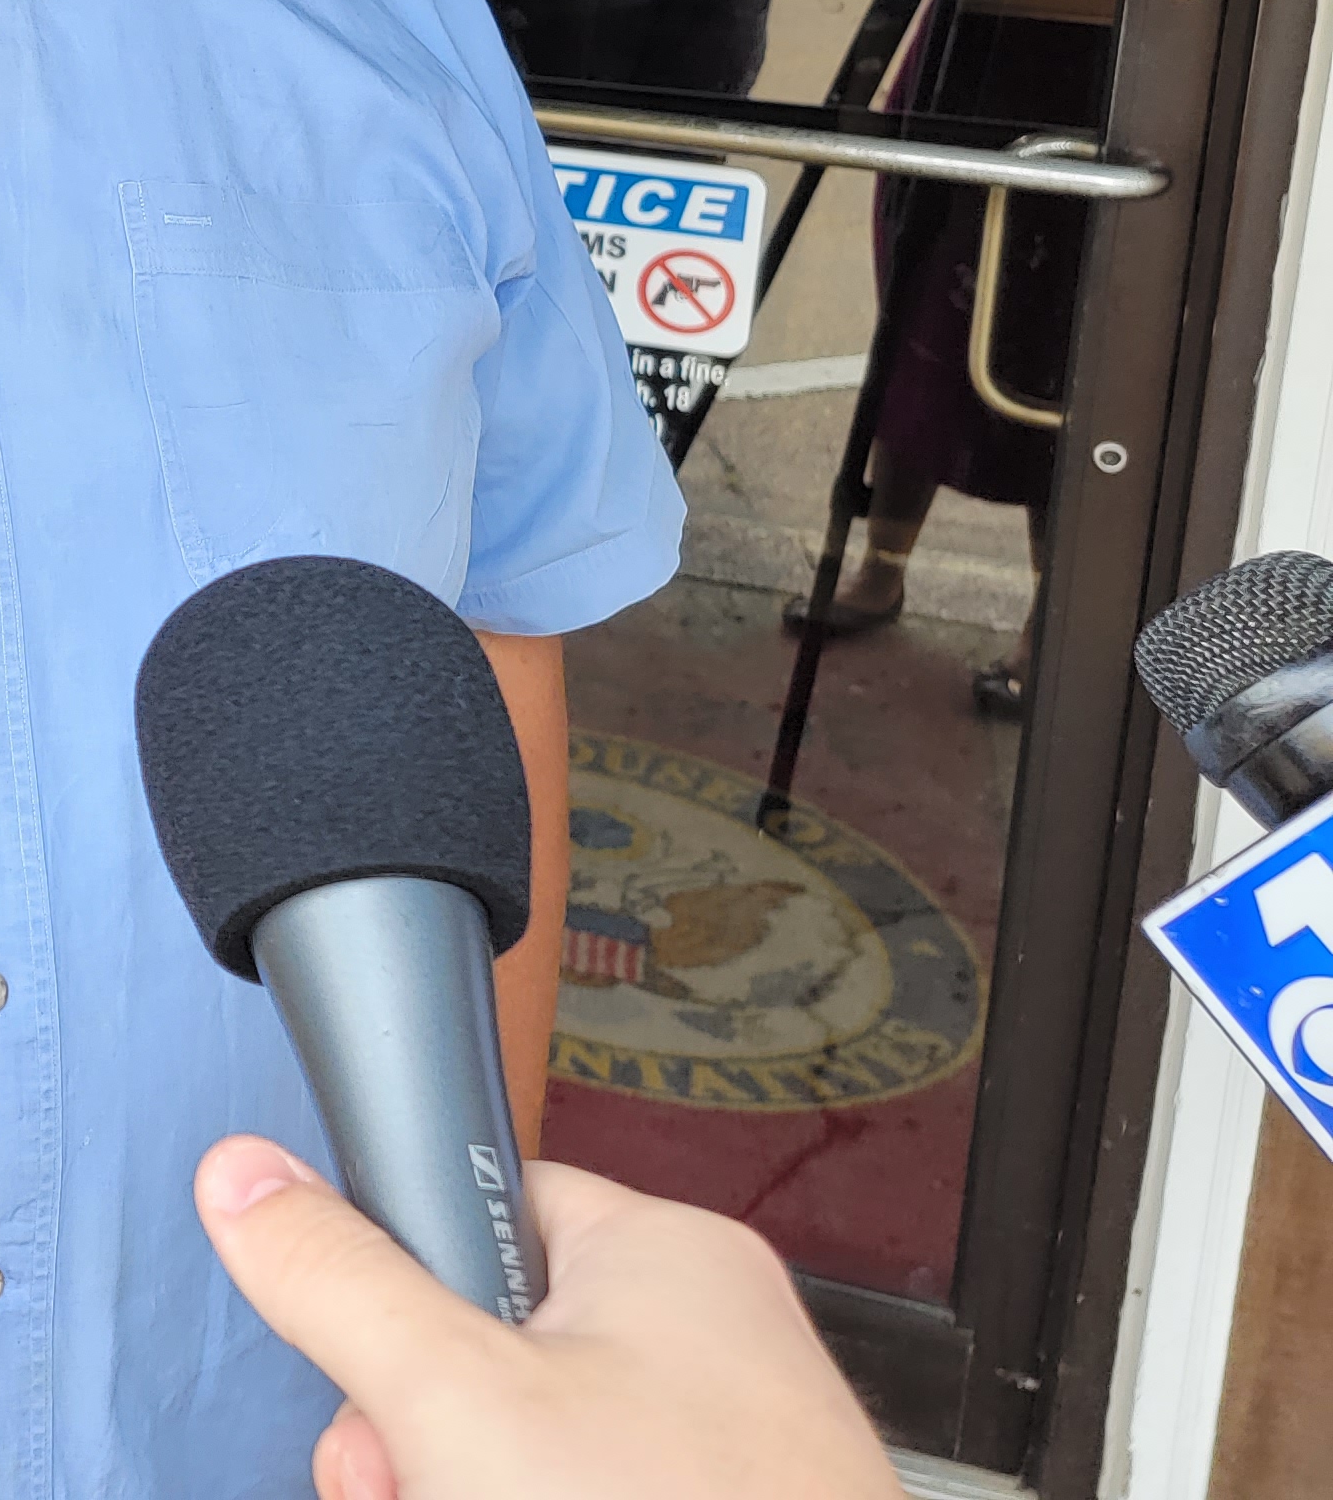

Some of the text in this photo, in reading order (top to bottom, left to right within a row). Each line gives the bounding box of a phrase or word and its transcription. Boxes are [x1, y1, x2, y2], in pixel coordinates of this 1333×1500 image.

[555, 168, 736, 234] TICE
[659, 358, 675, 381] a
[486, 1197, 532, 1321] SENNH
